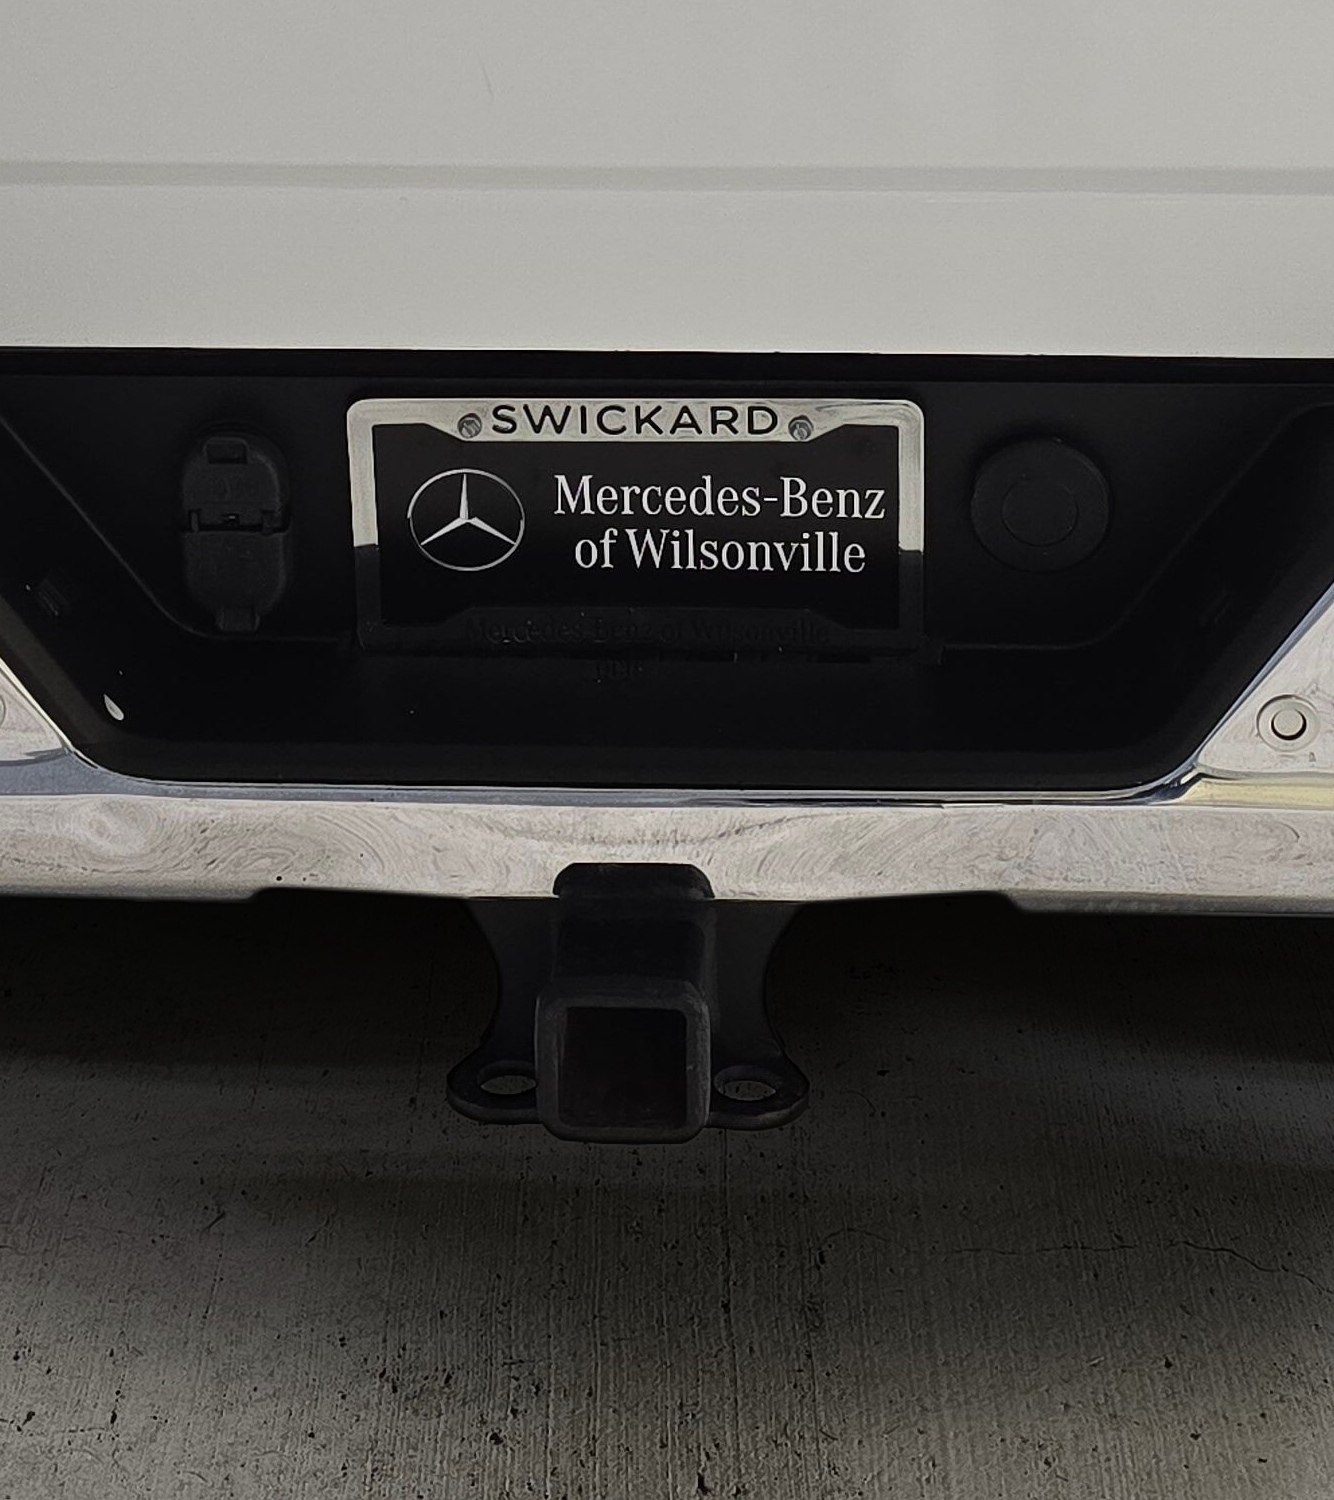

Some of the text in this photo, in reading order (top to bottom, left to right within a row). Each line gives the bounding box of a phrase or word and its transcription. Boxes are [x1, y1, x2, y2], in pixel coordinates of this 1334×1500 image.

[491, 403, 779, 436] SWICKARD
[553, 474, 887, 520] Mercedes-Benz
[574, 528, 867, 573] of Wilsonville
